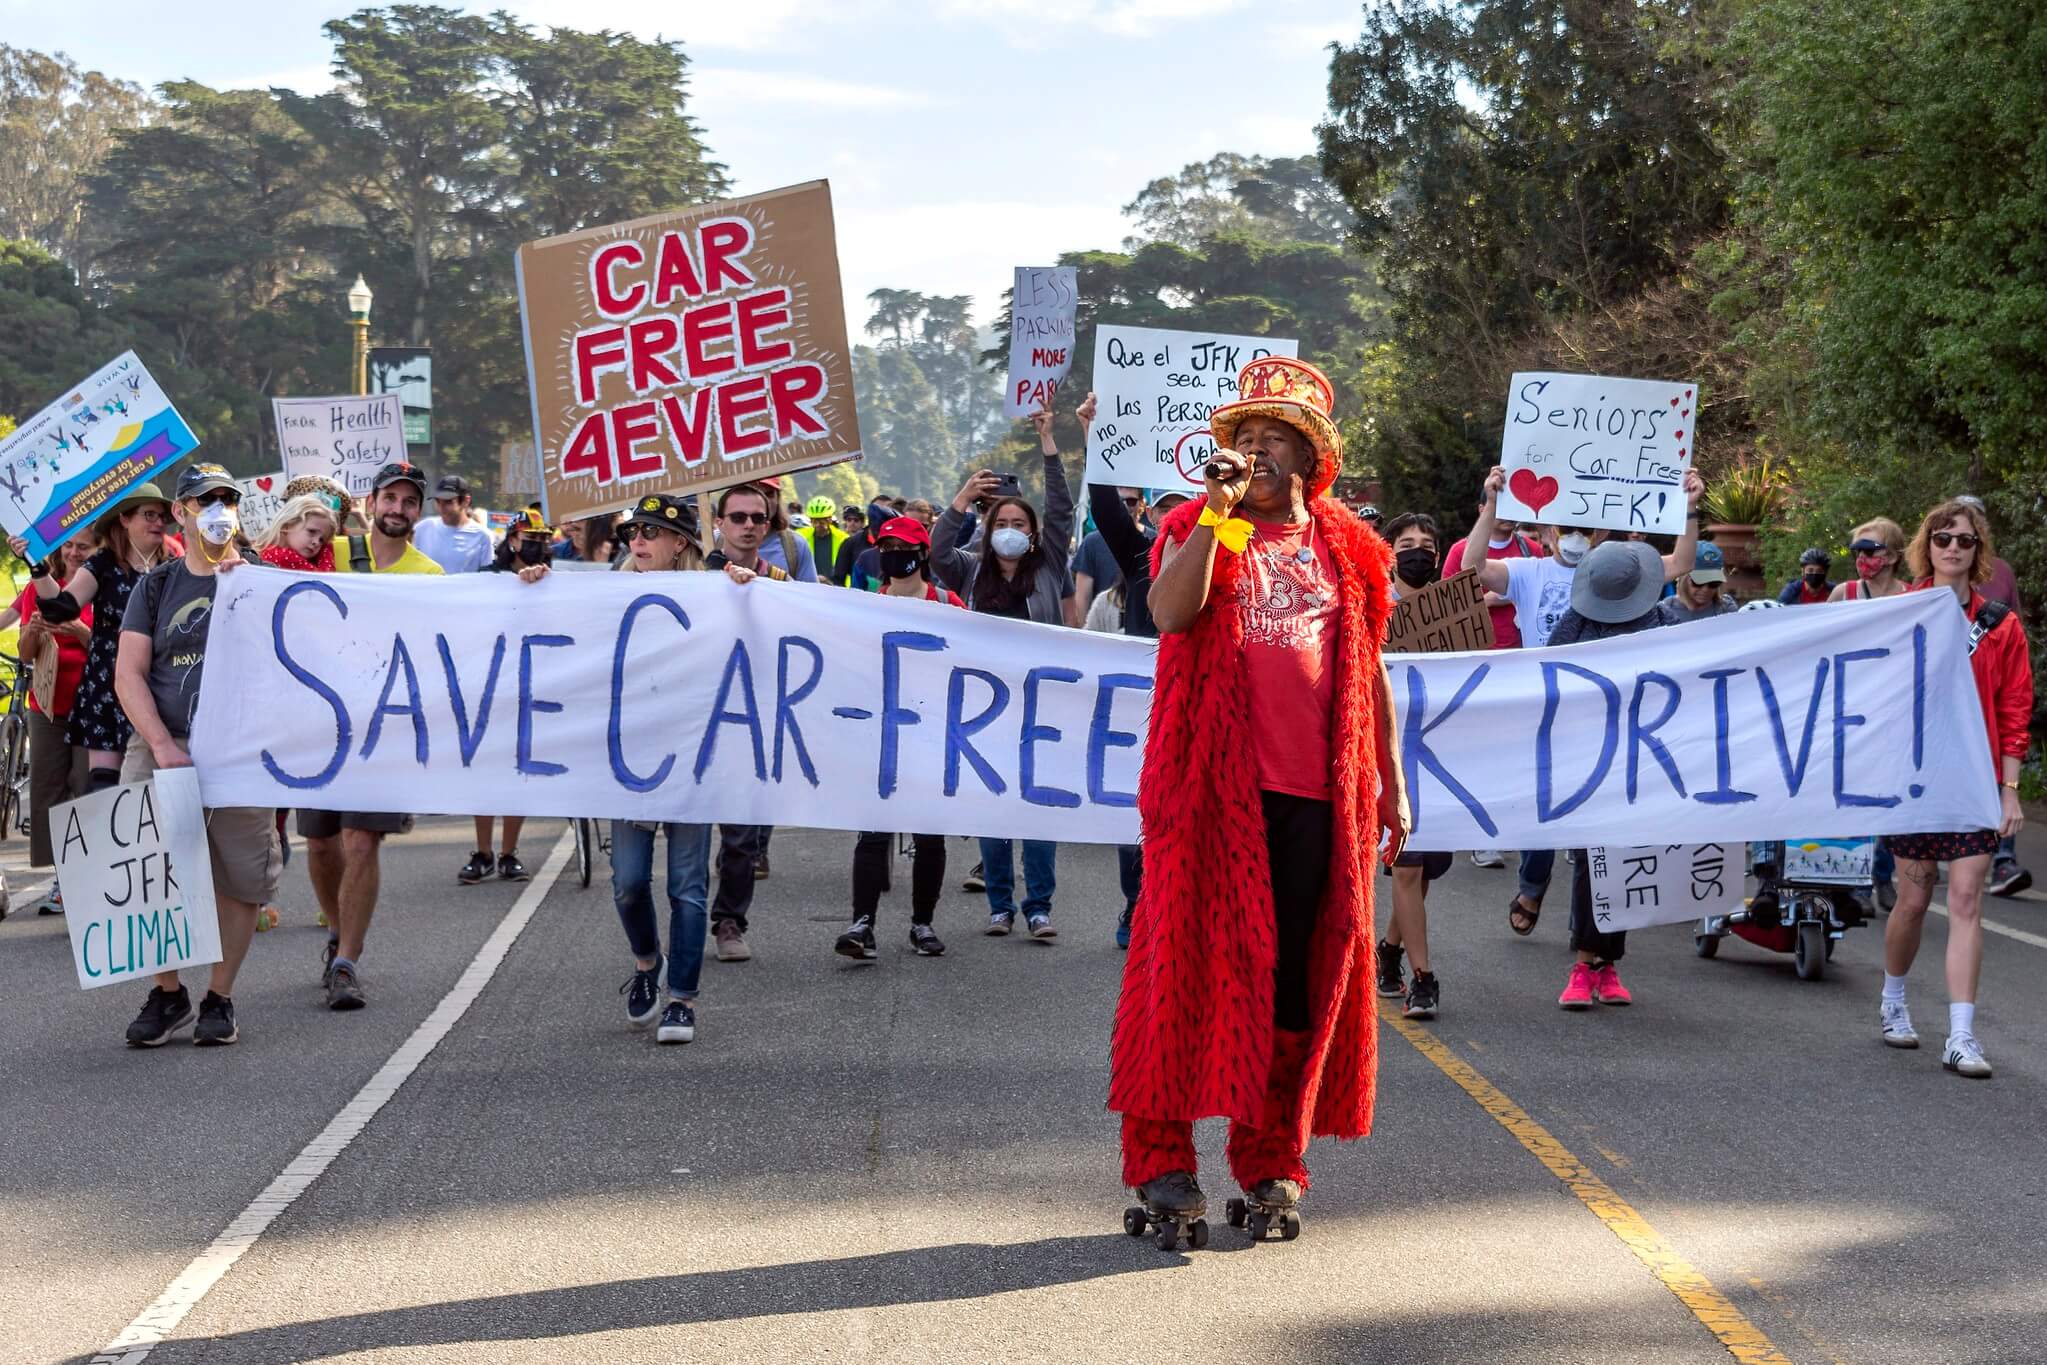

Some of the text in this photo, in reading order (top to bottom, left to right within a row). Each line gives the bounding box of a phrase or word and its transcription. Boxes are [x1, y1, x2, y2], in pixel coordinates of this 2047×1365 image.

[592, 218, 757, 319] CAR
[1018, 272, 1071, 309] LESS
[575, 288, 794, 406] FREE
[1016, 316, 1073, 343] PARKING
[1031, 347, 1067, 368] MORE
[1107, 337, 1240, 373] Que el JFK
[1166, 372, 1206, 388] sea
[331, 401, 392, 433] Health
[562, 364, 829, 484] 4EVER
[1514, 380, 1667, 440] Seniors
[1096, 423, 1117, 441] no
[331, 437, 391, 466] Safety
[1101, 434, 1138, 471] para
[1155, 440, 1175, 464] los
[1524, 442, 1683, 481] for Car Free
[60, 455, 155, 528] A car-free JFK Drive
[70, 458, 133, 508] for everyone!
[1570, 491, 1667, 528] JFK!
[1418, 572, 1485, 626] CLIMATE
[261, 579, 576, 789] SAVE
[606, 593, 1154, 808] CAR-FREE
[1535, 622, 1929, 824] DRIVE!
[62, 784, 160, 864] A CA
[104, 852, 179, 907] JFK
[1594, 892, 1612, 923] JFK
[83, 906, 191, 978] CLIMAT
